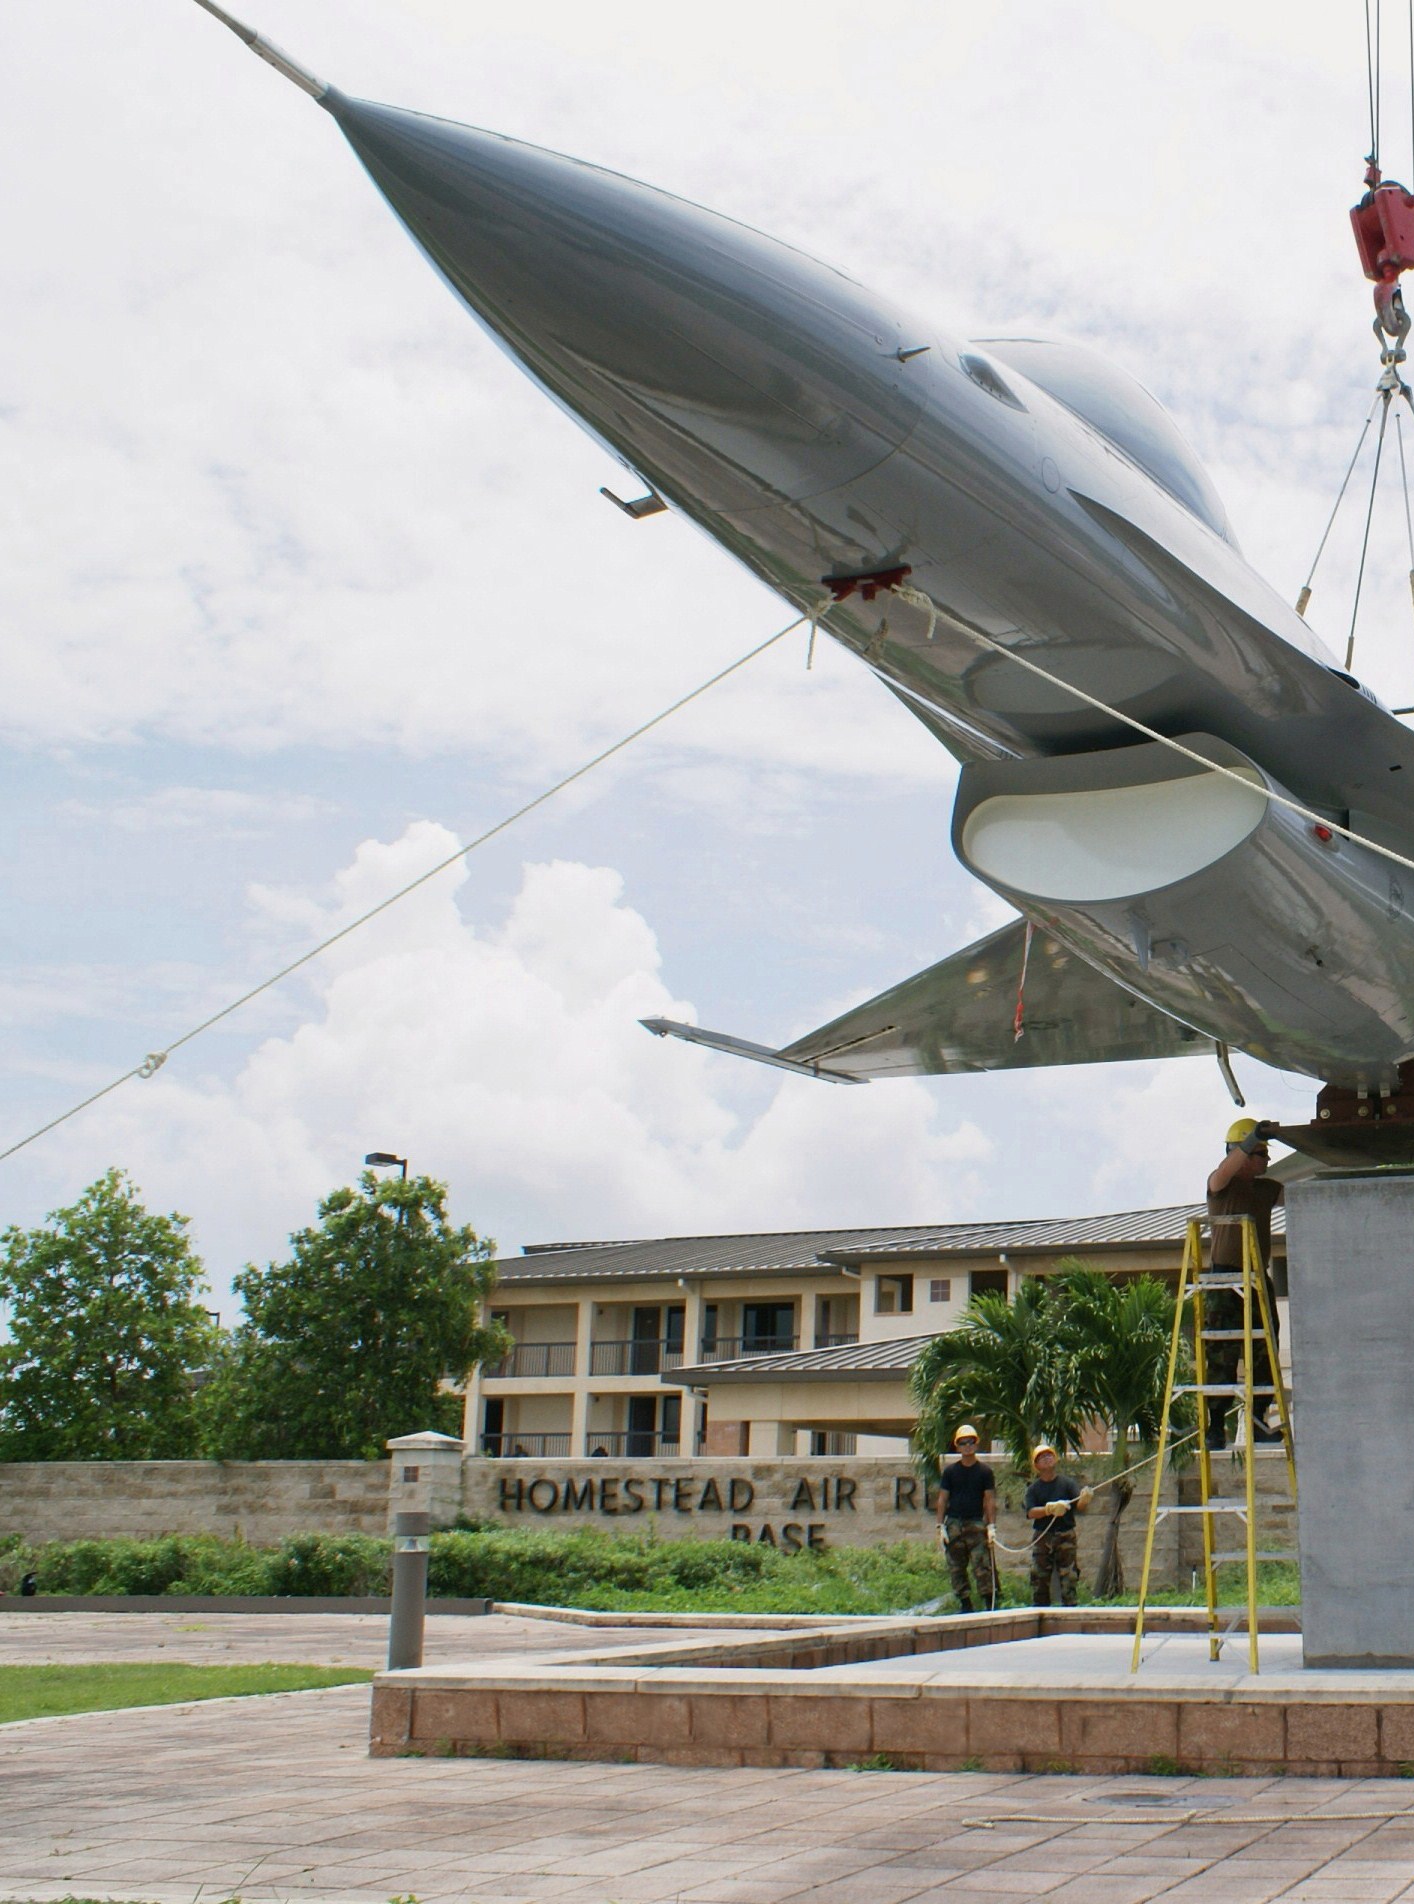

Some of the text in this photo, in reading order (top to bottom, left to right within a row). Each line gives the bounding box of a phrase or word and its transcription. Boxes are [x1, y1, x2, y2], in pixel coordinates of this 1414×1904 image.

[499, 1477, 755, 1513] HOMESTEAD
[789, 1476, 858, 1512] AIR
[731, 1522, 826, 1554] BASE
